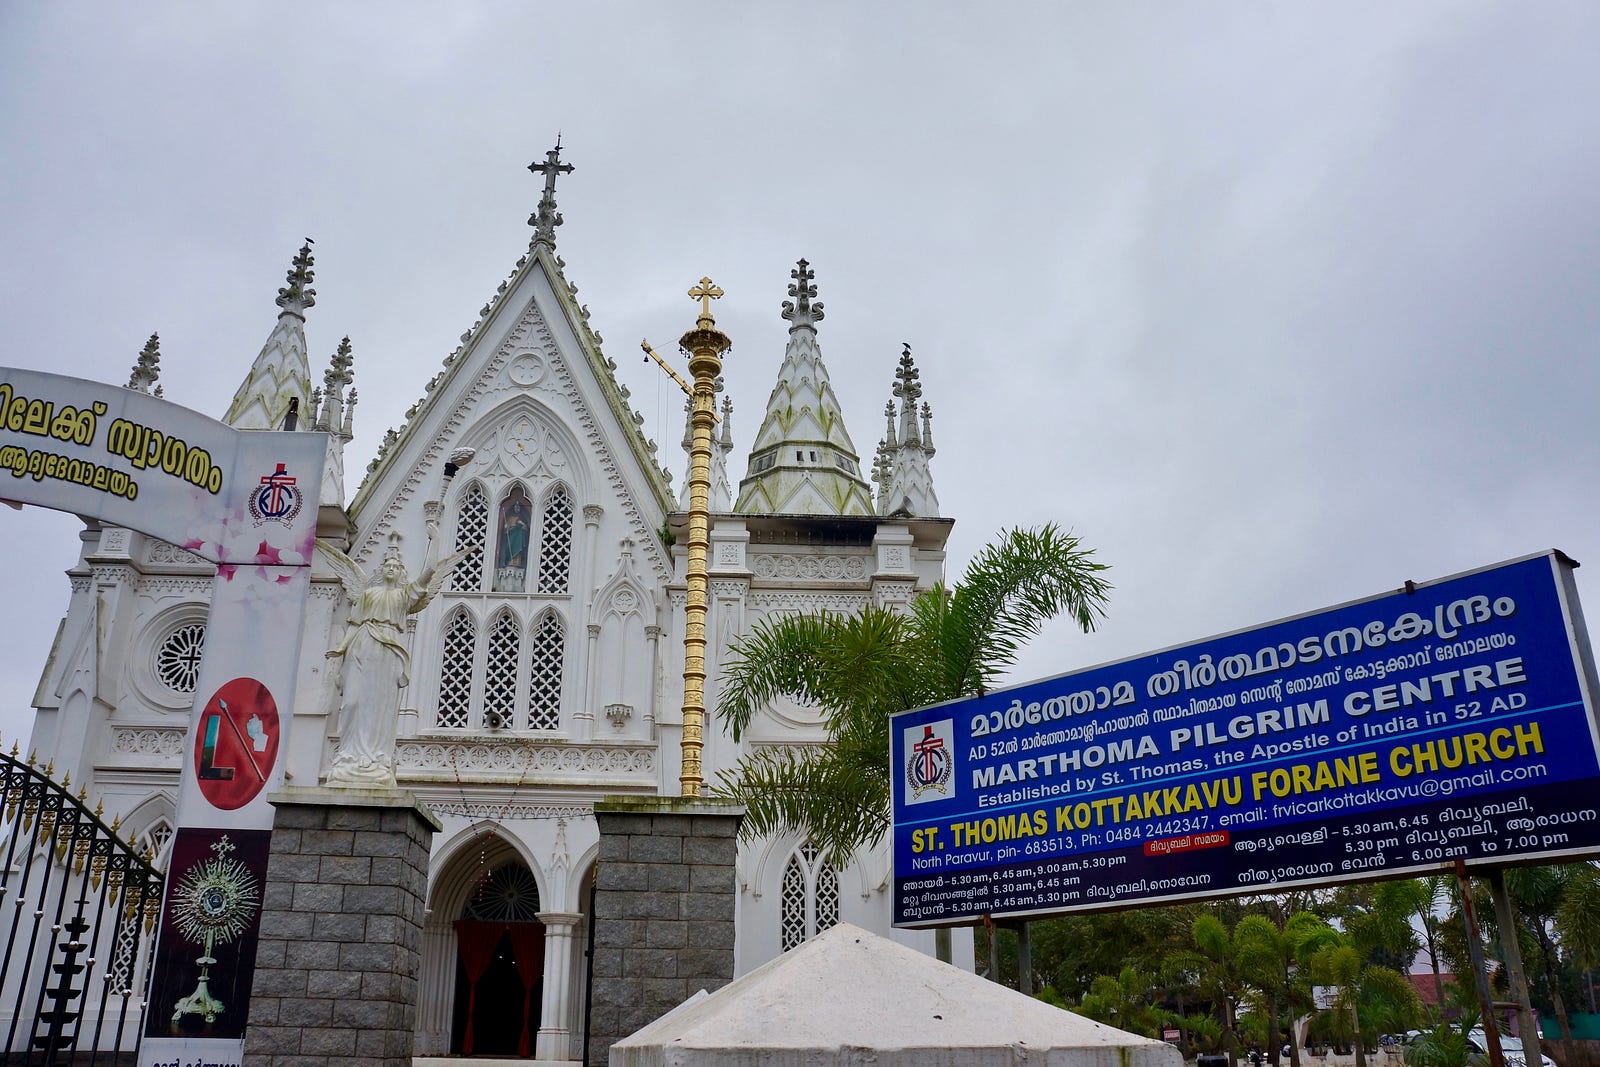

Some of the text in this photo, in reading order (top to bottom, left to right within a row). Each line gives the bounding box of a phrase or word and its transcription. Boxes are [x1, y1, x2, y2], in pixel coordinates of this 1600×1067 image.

[107, 417, 223, 495] സ്വാഗതം
[968, 744, 987, 762] AD
[990, 737, 1018, 757] 52ൽ
[1153, 693, 1236, 723] സ്ഥാപിതമായ
[1286, 665, 1341, 695] തോമസ്
[1344, 644, 1431, 682] കോട്ടക്കാവ്
[1435, 632, 1516, 662] ദേവാലയം
[970, 595, 1516, 738] മാർത്തോമ തീർത്ഥാടനകേന്ദ്രം
[972, 656, 1527, 789] MARTHOMA PILGRIM CENTRE
[978, 692, 1527, 808] Established by St. Thomas, the Apostle of India in 52 AD
[911, 721, 1544, 853] ST. THOMAS KOTTAKKAVU FORANE CHURCH
[912, 763, 1548, 870] North Paravur, pin- 683513, Ph: 0484 2442347, email: frvicarkottakkavu@gmail.com
[1108, 855, 1127, 867] pm
[1194, 833, 1225, 845] സമയം
[1234, 826, 1328, 852] ആദ്യവെള്ളി
[1342, 823, 1370, 836] 5.30
[1238, 861, 1333, 884] നിത്യാരാധന
[1341, 853, 1386, 871] ഭവൻ
[1411, 848, 1443, 861] 6.00
[1445, 845, 1468, 857] am
[1481, 840, 1498, 852] to
[1504, 834, 1538, 849] 7.00
[1542, 832, 1569, 848] pm
[1345, 840, 1373, 853] 5.30
[1376, 837, 1399, 851] pm
[1506, 809, 1597, 832] ആരാധന
[993, 883, 1015, 894] 5.30
[1063, 876, 1081, 886] am
[1062, 890, 1080, 902] pm
